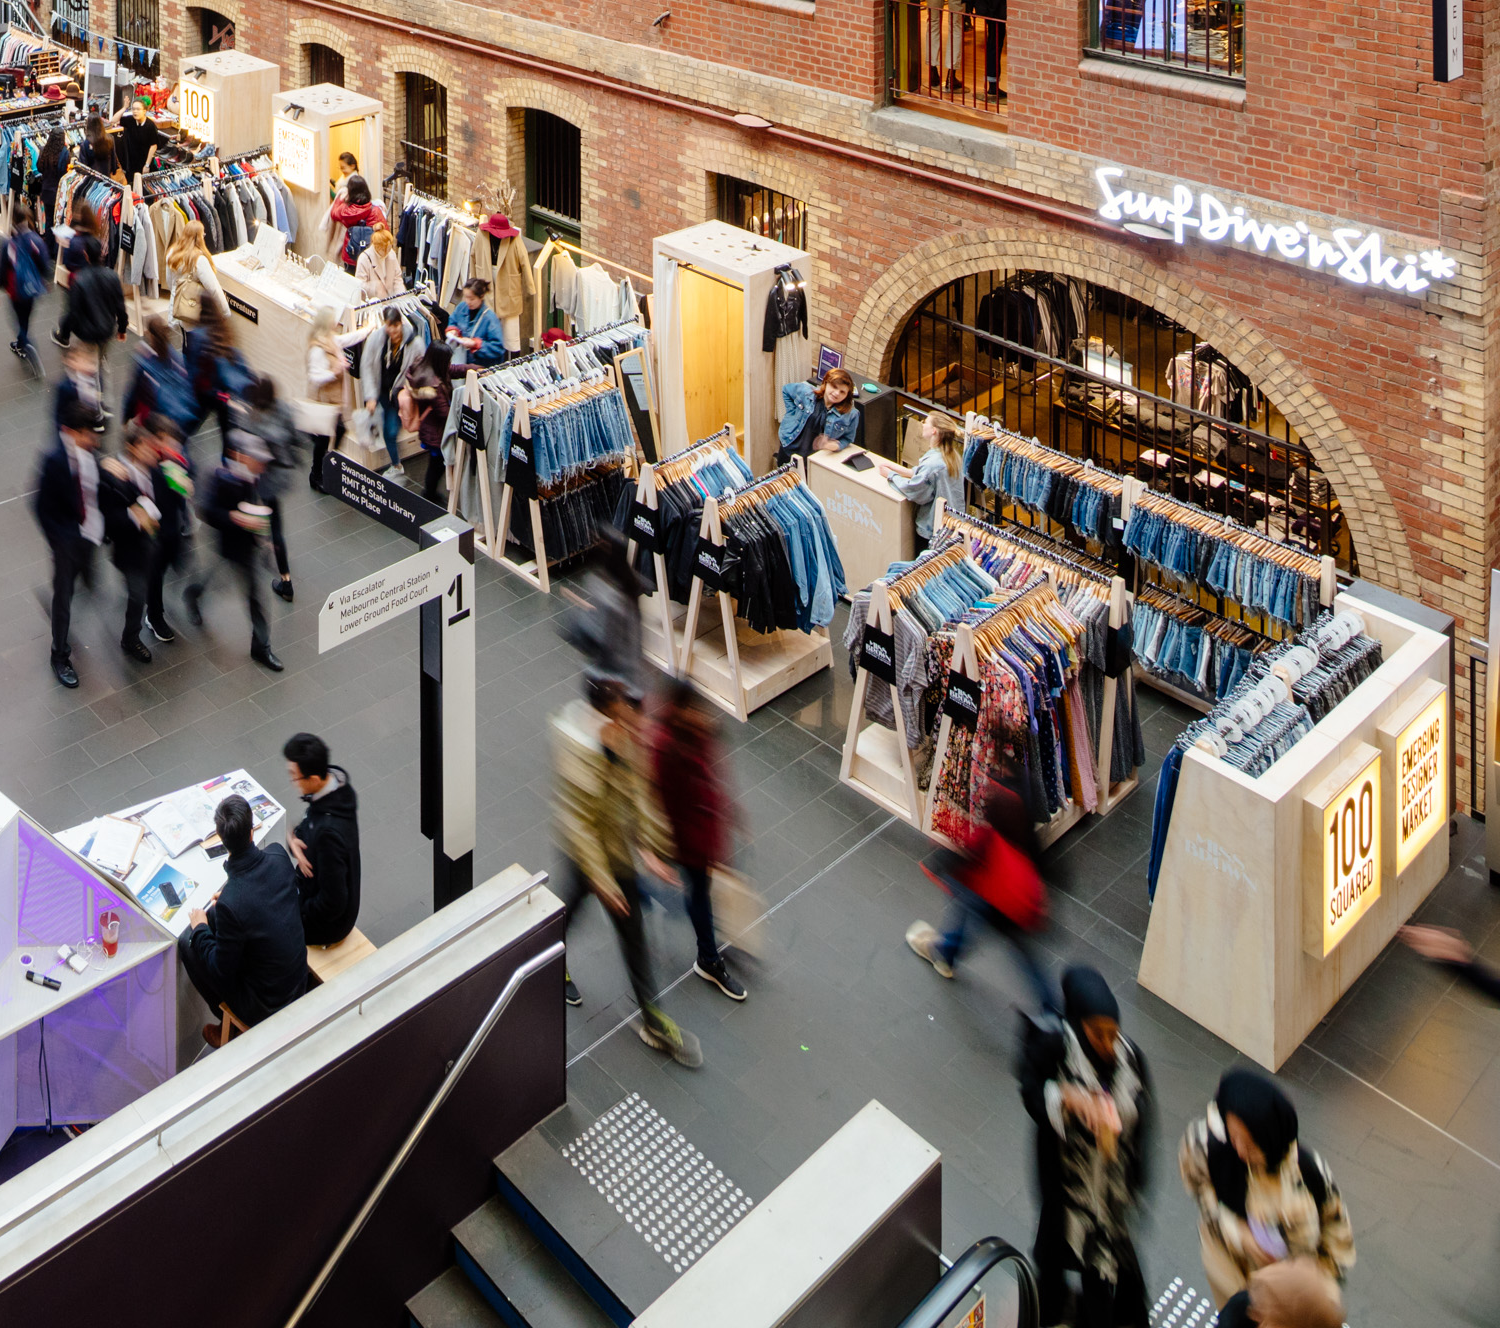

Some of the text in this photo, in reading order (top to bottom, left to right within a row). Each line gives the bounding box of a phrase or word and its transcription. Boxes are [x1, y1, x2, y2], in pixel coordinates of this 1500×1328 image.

[184, 87, 210, 123] 100
[184, 116, 210, 137] SQUARED
[278, 127, 310, 150] EMERGING
[1095, 167, 1200, 244] Surf
[341, 461, 387, 494] Swanston St.
[341, 474, 416, 522] RMIT & State Library
[341, 486, 381, 515] Knox Place
[339, 578, 386, 606] Via Escalator
[339, 584, 429, 634] Lower Ground Food Court
[340, 571, 431, 620] Melbourne Central Station
[447, 573, 471, 627] 1
[1401, 717, 1440, 771] EMERGING
[1401, 754, 1439, 812] DESIGNER
[1329, 779, 1373, 891] 100
[1401, 785, 1433, 845] MARKET
[1330, 857, 1374, 927] SQUARED
